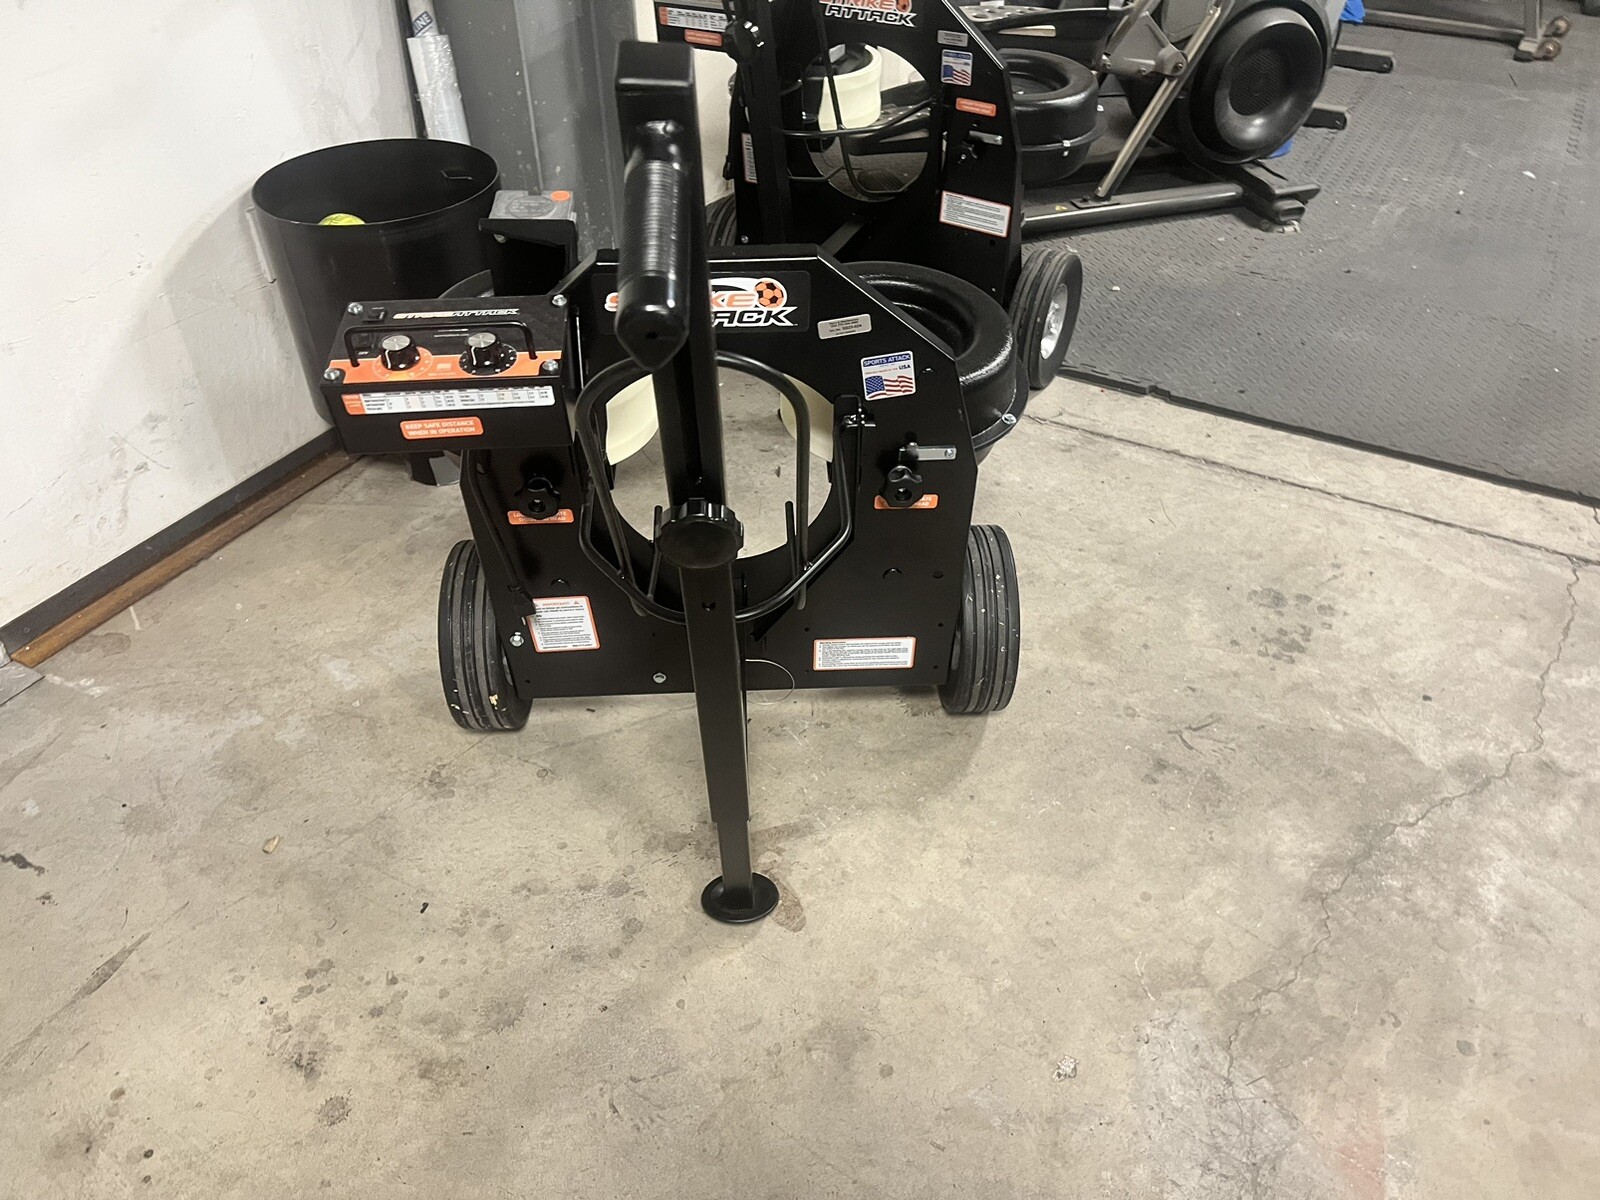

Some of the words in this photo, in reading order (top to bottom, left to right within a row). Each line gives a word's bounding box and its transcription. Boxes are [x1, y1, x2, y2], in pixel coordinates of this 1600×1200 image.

[819, 0, 895, 11] RIKE
[825, 4, 917, 27] ATTACK
[413, 13, 432, 33] INE
[863, 357, 887, 366] SPORTS
[888, 354, 911, 362] ATTACK
[424, 421, 441, 429] SAFE
[441, 420, 475, 428] DISTANCE
